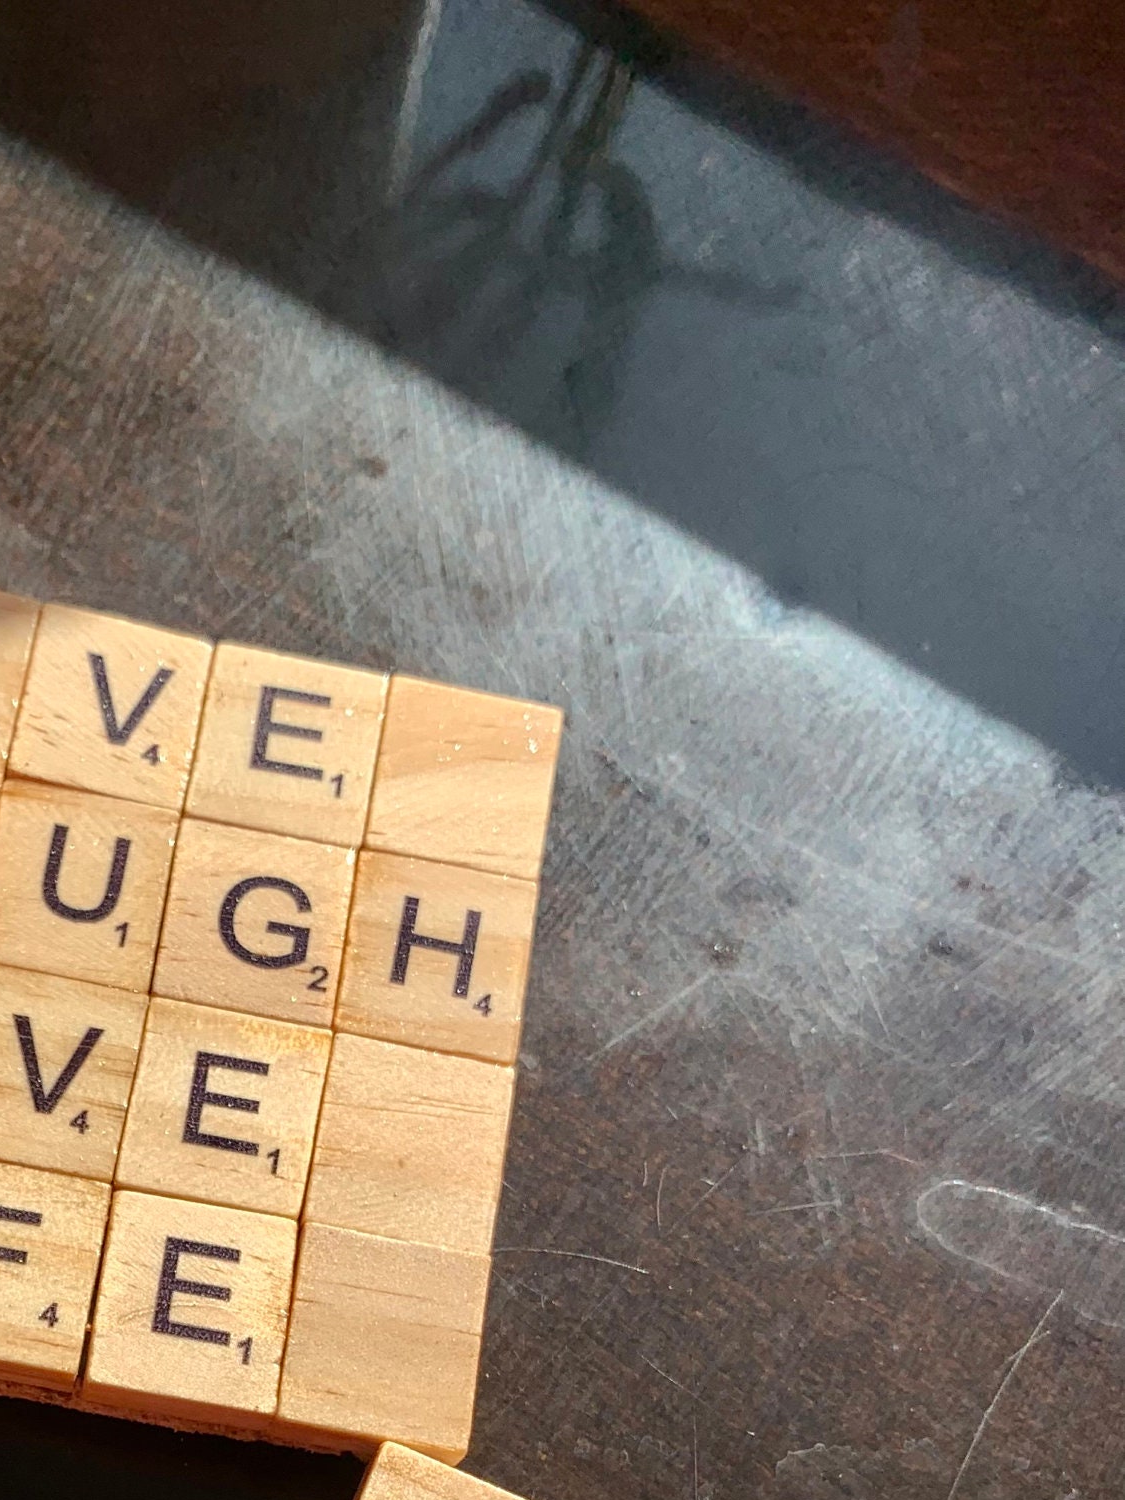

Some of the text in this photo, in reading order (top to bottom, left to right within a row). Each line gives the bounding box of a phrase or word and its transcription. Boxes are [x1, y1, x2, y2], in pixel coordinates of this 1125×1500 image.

[141, 743, 161, 766] 4
[330, 773, 344, 799] 1
[114, 921, 130, 948] 1
[306, 965, 330, 994] 2
[473, 993, 492, 1017] 4
[68, 1109, 90, 1135] 4
[266, 1148, 281, 1179] 1
[37, 1302, 60, 1329] 4
[236, 1336, 254, 1366] 1
